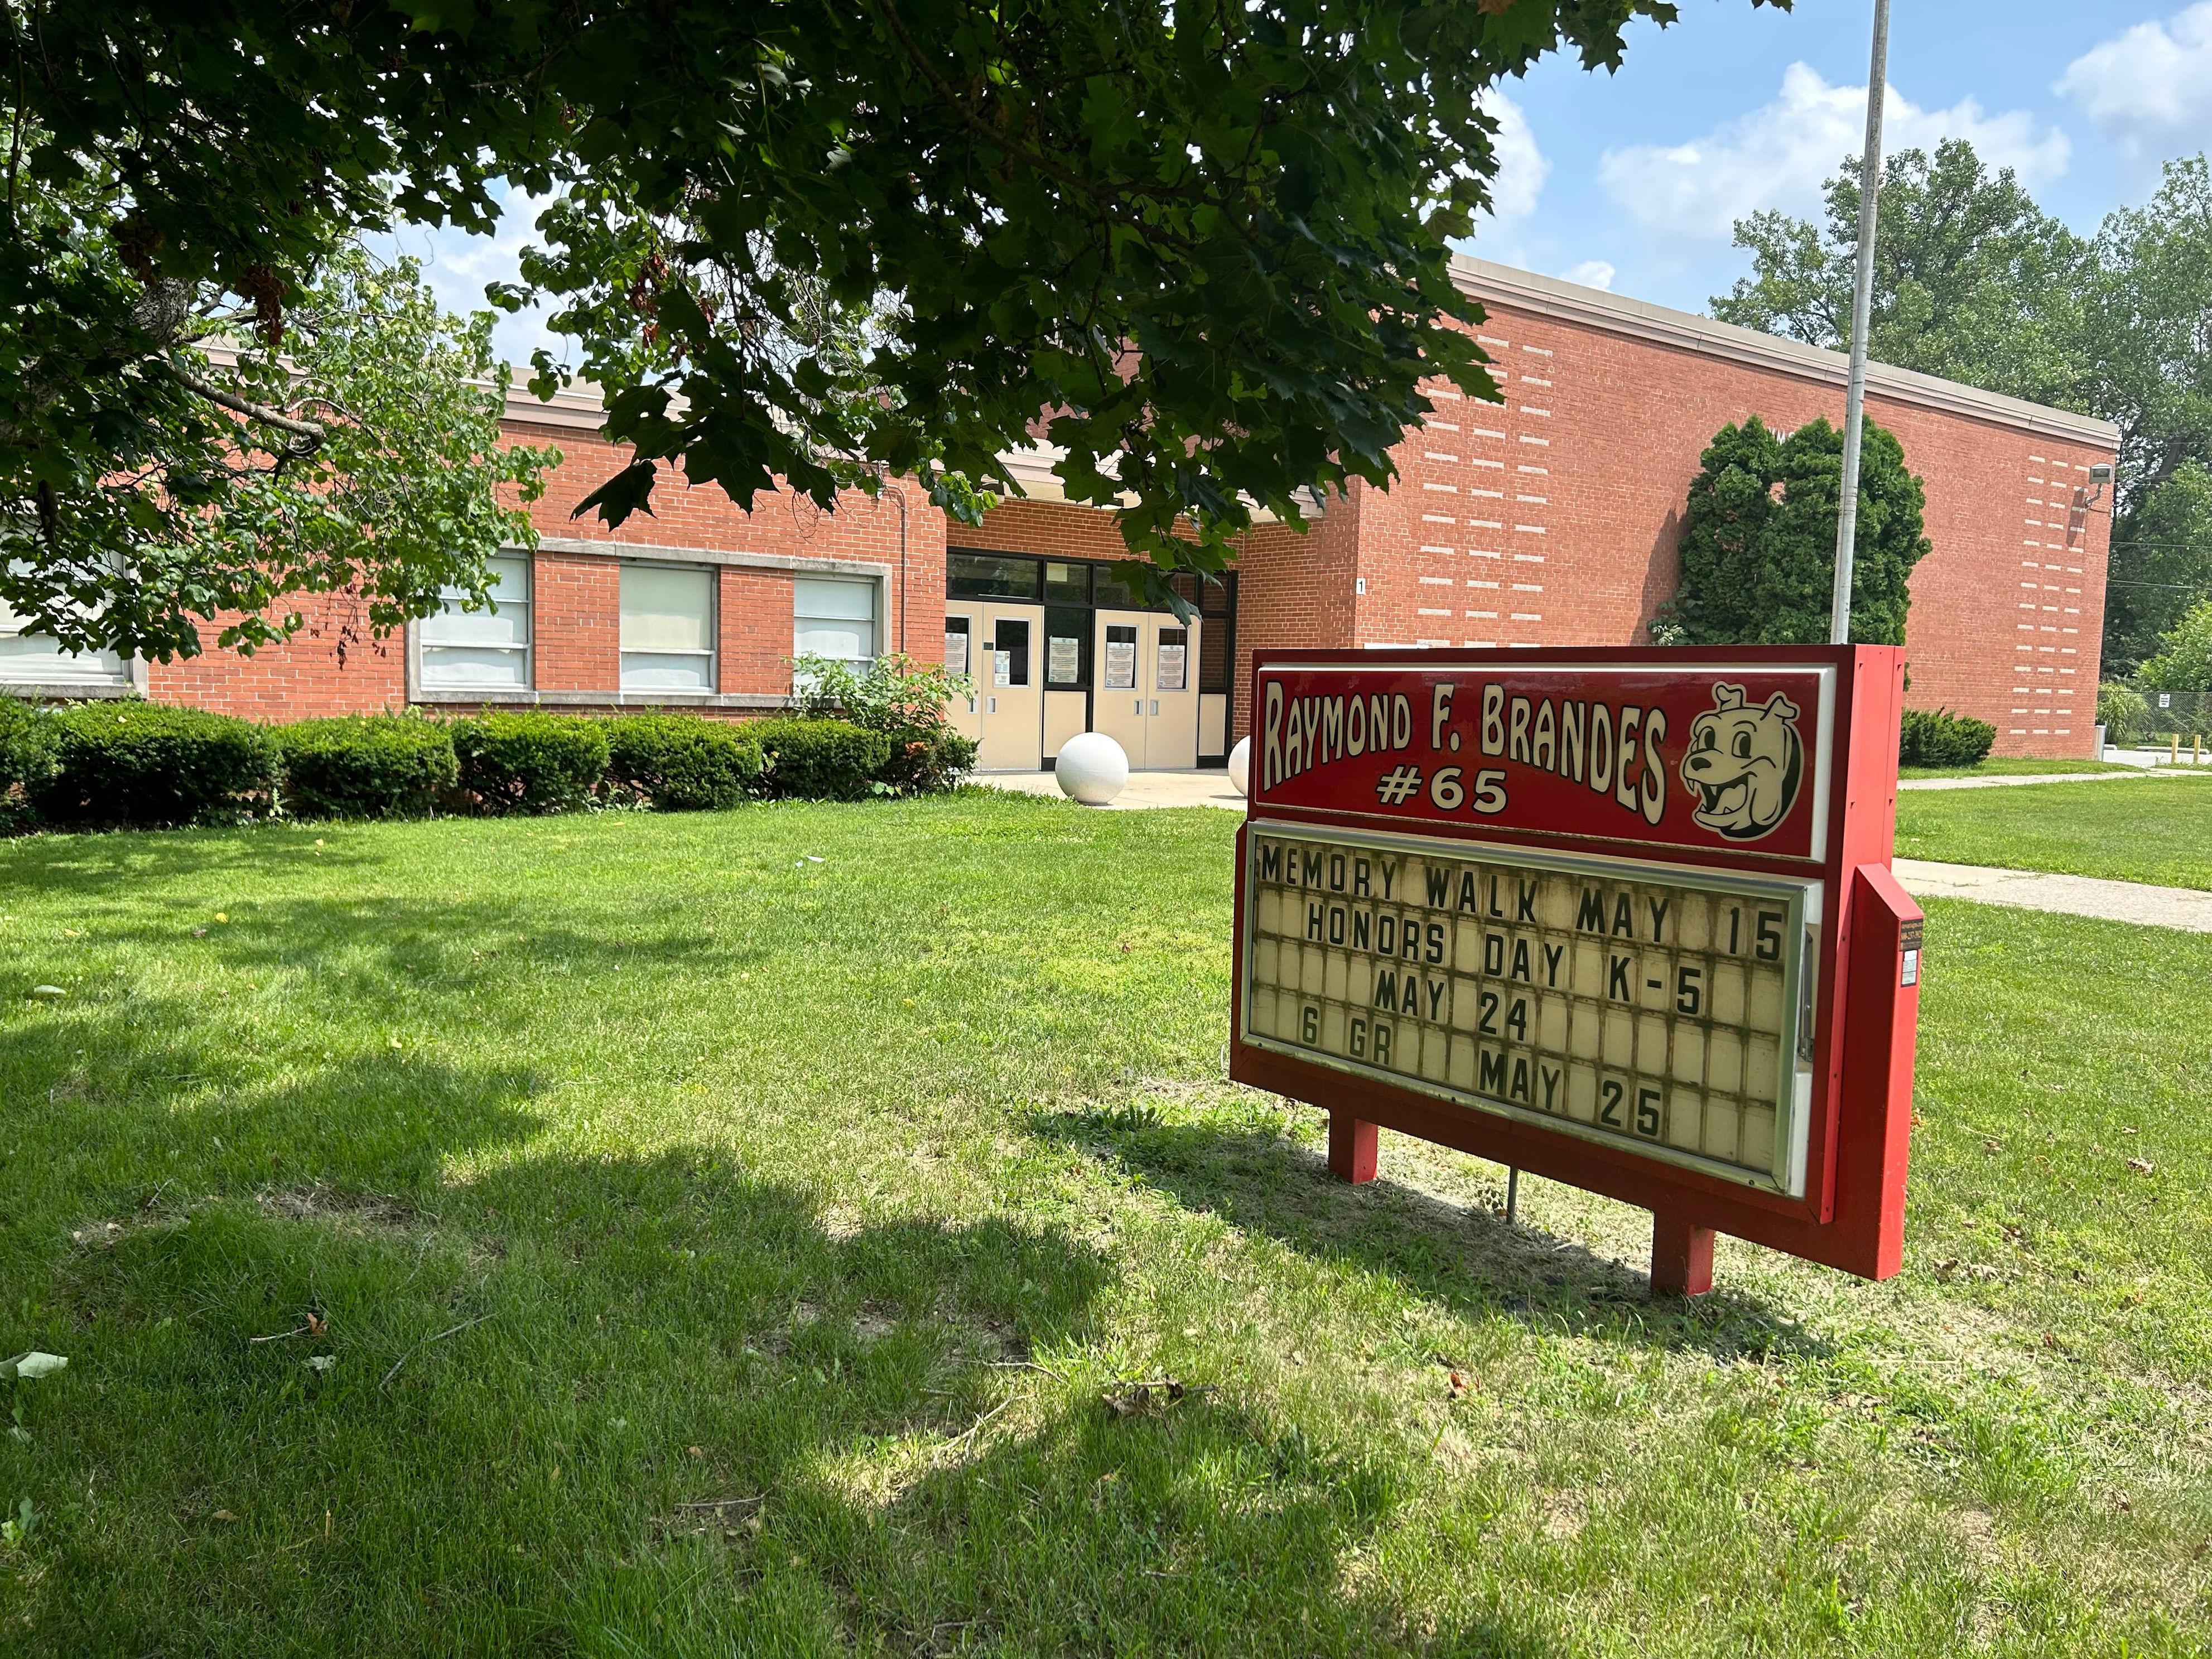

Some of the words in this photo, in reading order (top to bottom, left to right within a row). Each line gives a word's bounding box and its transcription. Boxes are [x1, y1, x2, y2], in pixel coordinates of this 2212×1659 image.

[1358, 580, 1363, 592] 1
[1263, 678, 1412, 793] RAYMOND
[1432, 683, 1461, 753] F.
[1481, 683, 1667, 827] BRANDES
[1376, 765, 1508, 815] #65
[1262, 844, 1396, 901] MEMORY
[1425, 867, 1538, 922] WALK
[1577, 888, 1669, 943] MAY
[1729, 906, 1782, 961] 15
[1308, 904, 1444, 964] HONORS
[1485, 933, 1564, 987] DAY
[1609, 954, 1700, 1015] K-5
[1375, 970, 1445, 1021] MAY
[1480, 991, 1527, 1041] 24
[1302, 1005, 1317, 1044] 6
[1350, 1017, 1392, 1063] GR
[1480, 1050, 1560, 1110] MAY
[1601, 1079, 1661, 1137] 25
